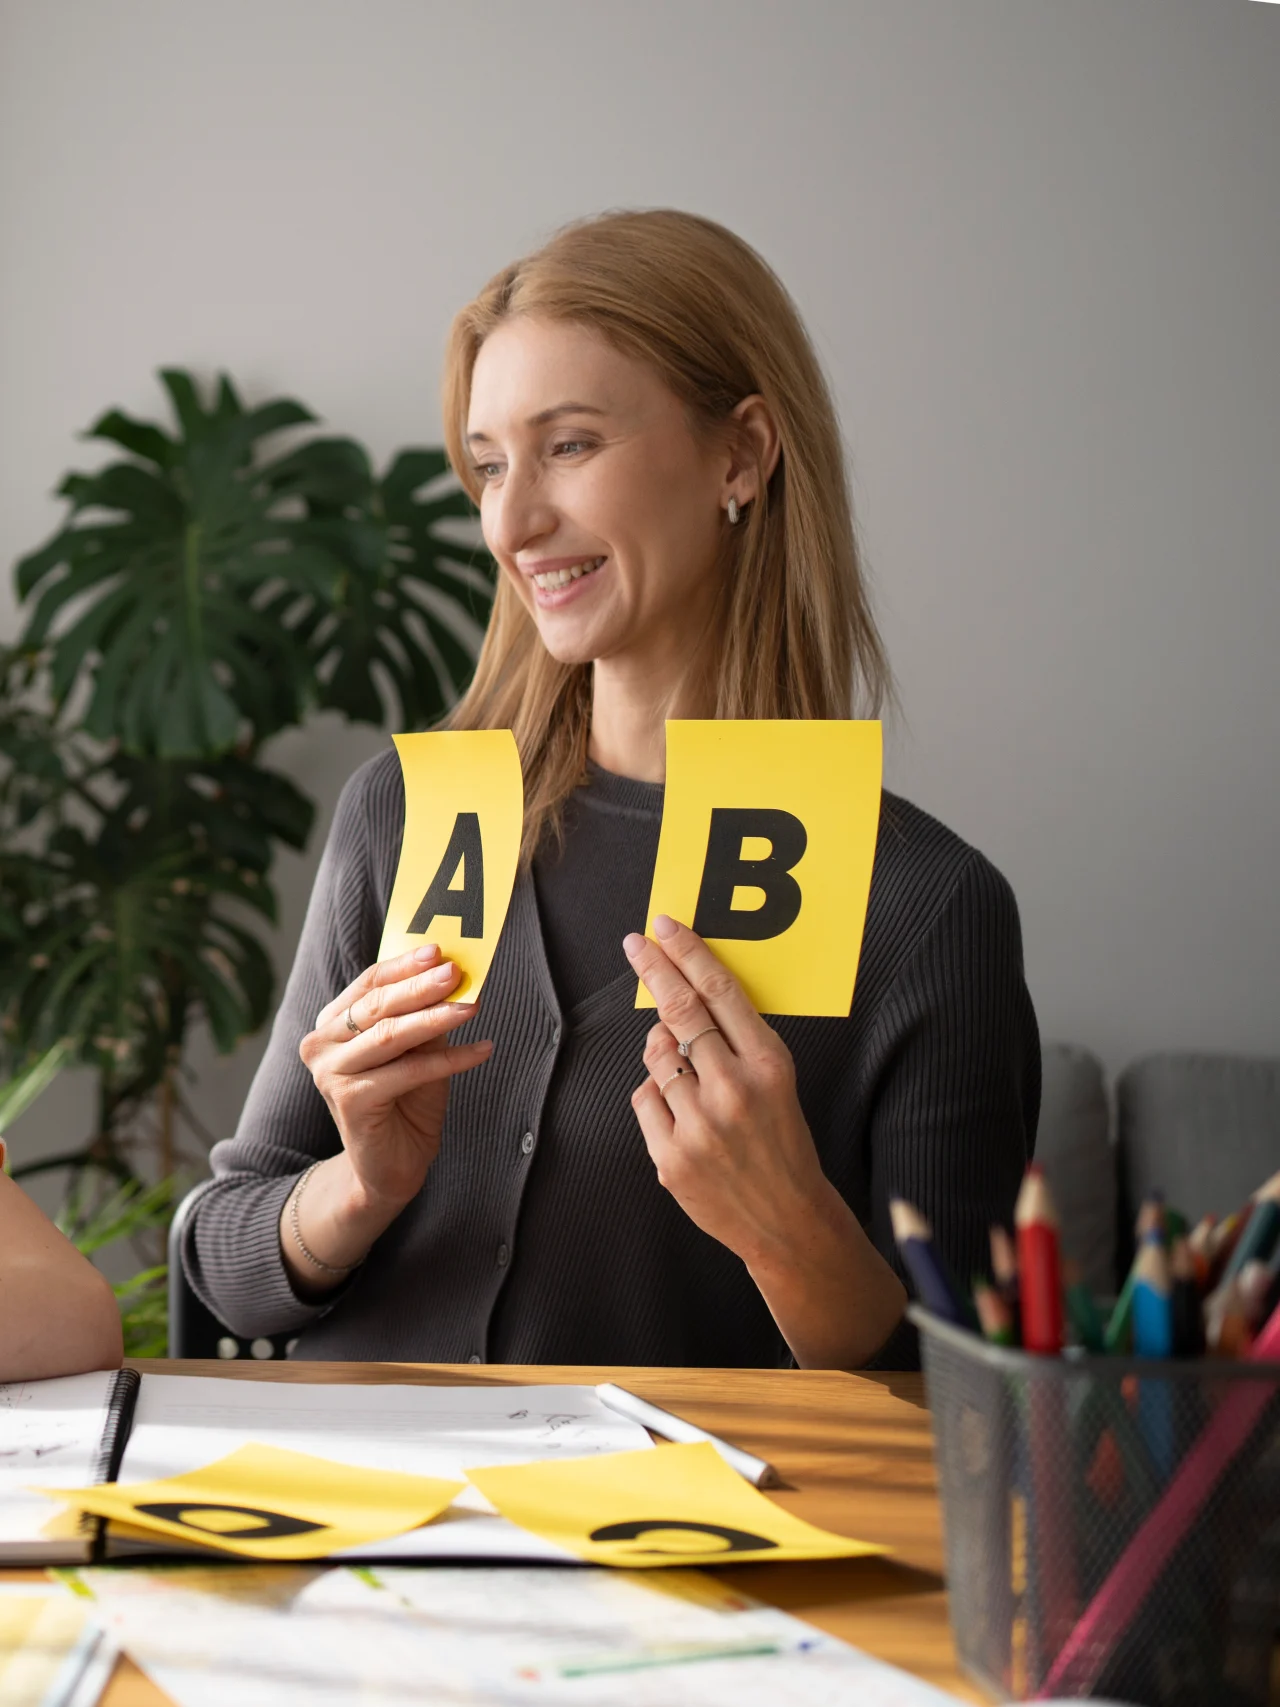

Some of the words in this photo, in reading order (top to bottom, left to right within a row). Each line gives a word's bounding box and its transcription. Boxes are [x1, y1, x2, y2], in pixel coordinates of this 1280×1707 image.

[406, 812, 484, 939] A
[692, 807, 808, 941] B
[589, 1520, 780, 1554] C
